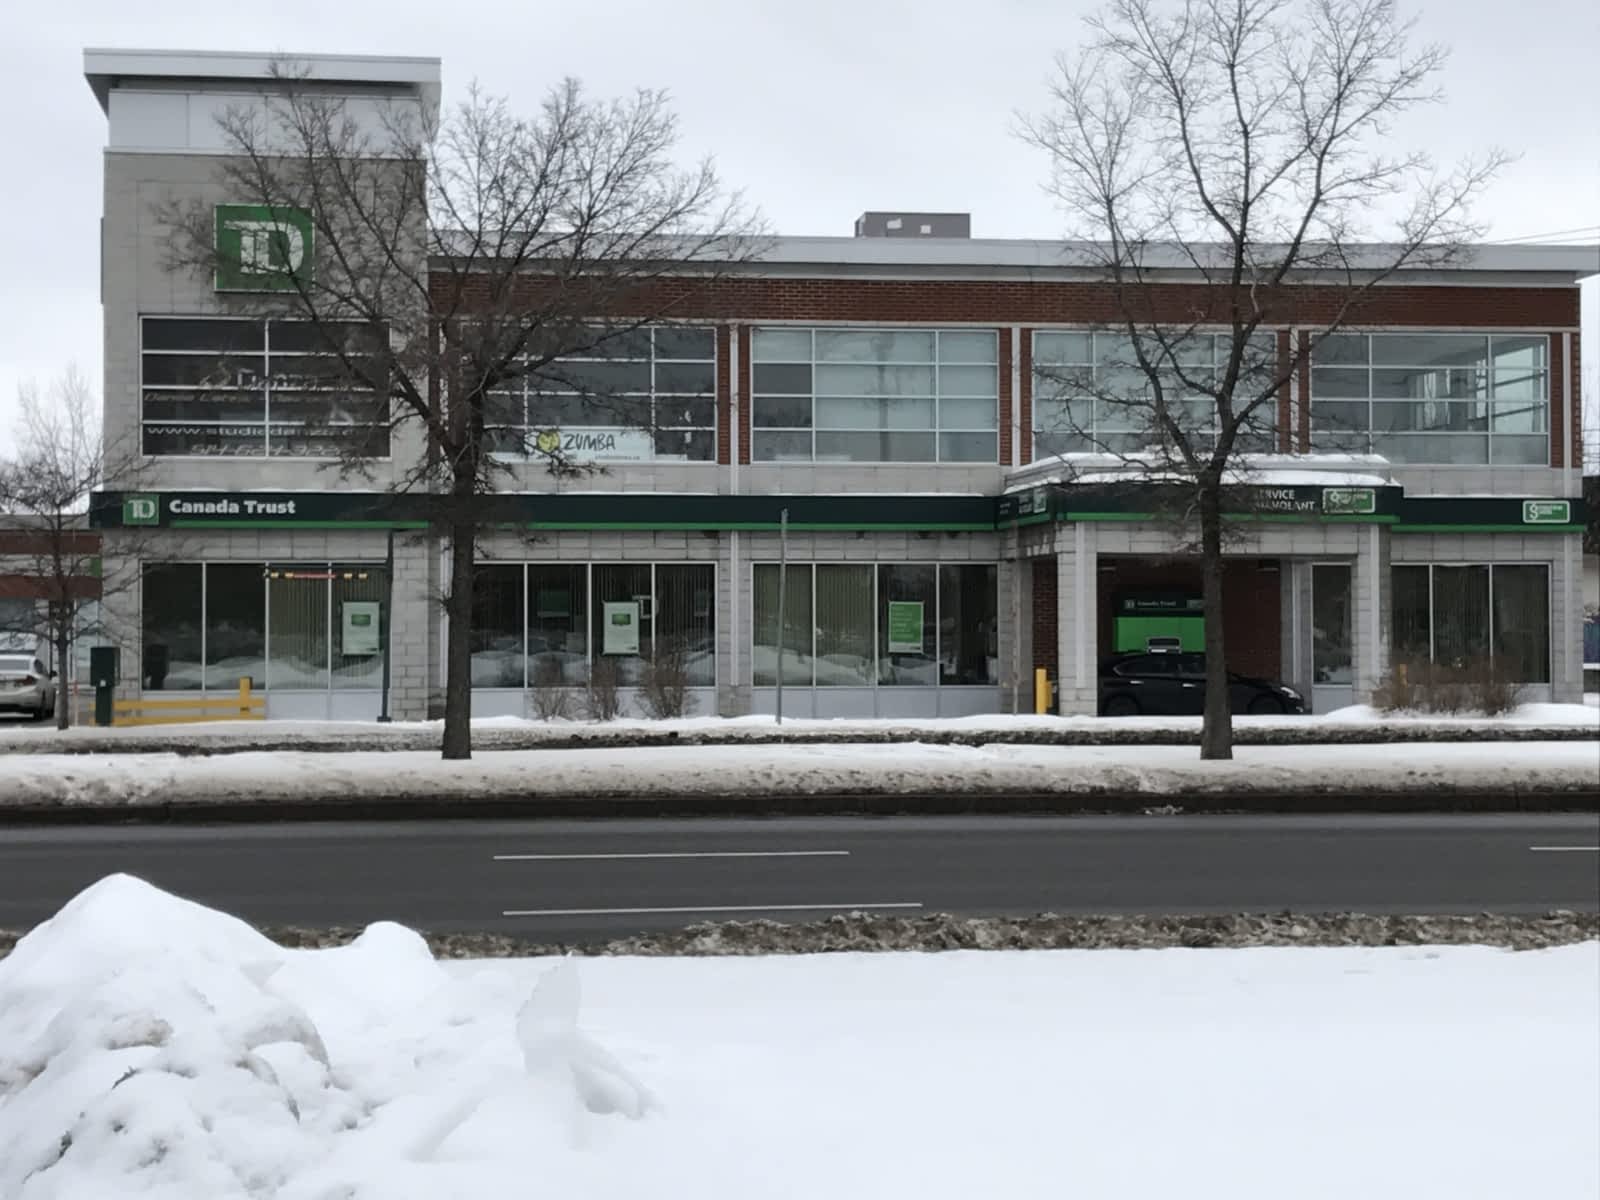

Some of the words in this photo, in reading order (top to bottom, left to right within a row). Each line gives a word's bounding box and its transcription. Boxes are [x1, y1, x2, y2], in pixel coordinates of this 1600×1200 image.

[224, 221, 304, 274] TD
[563, 433, 616, 451] ZUMBA
[128, 500, 156, 518] TD
[169, 499, 240, 514] Canada
[243, 500, 296, 514] Trust
